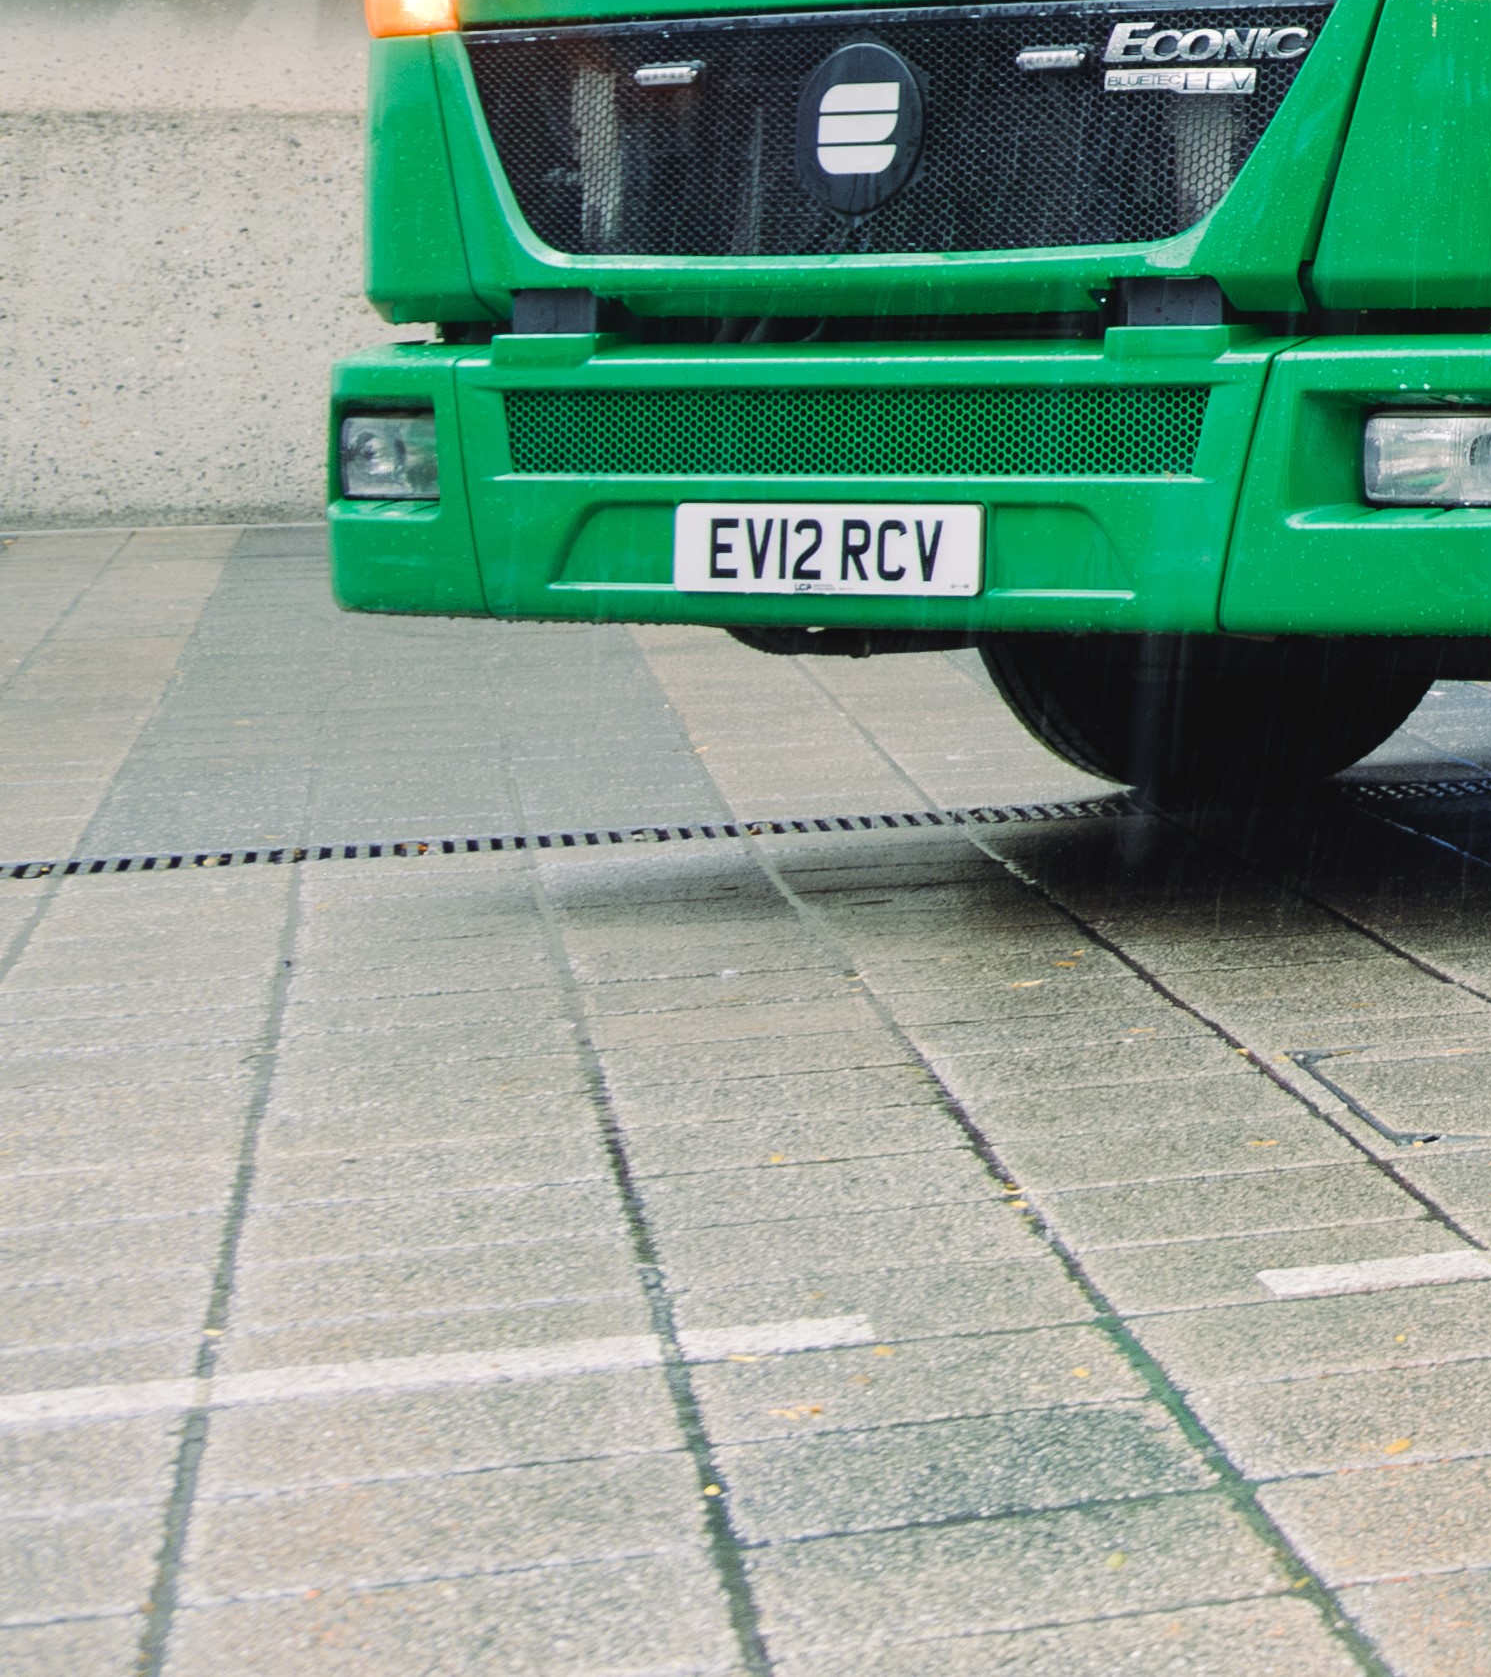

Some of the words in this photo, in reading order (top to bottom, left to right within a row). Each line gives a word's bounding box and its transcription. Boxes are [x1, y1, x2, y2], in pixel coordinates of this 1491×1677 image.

[1103, 22, 1309, 62] ECONIC
[1107, 73, 1182, 86] BLUETEC
[709, 518, 823, 580] EV12
[840, 519, 944, 581] RCV
